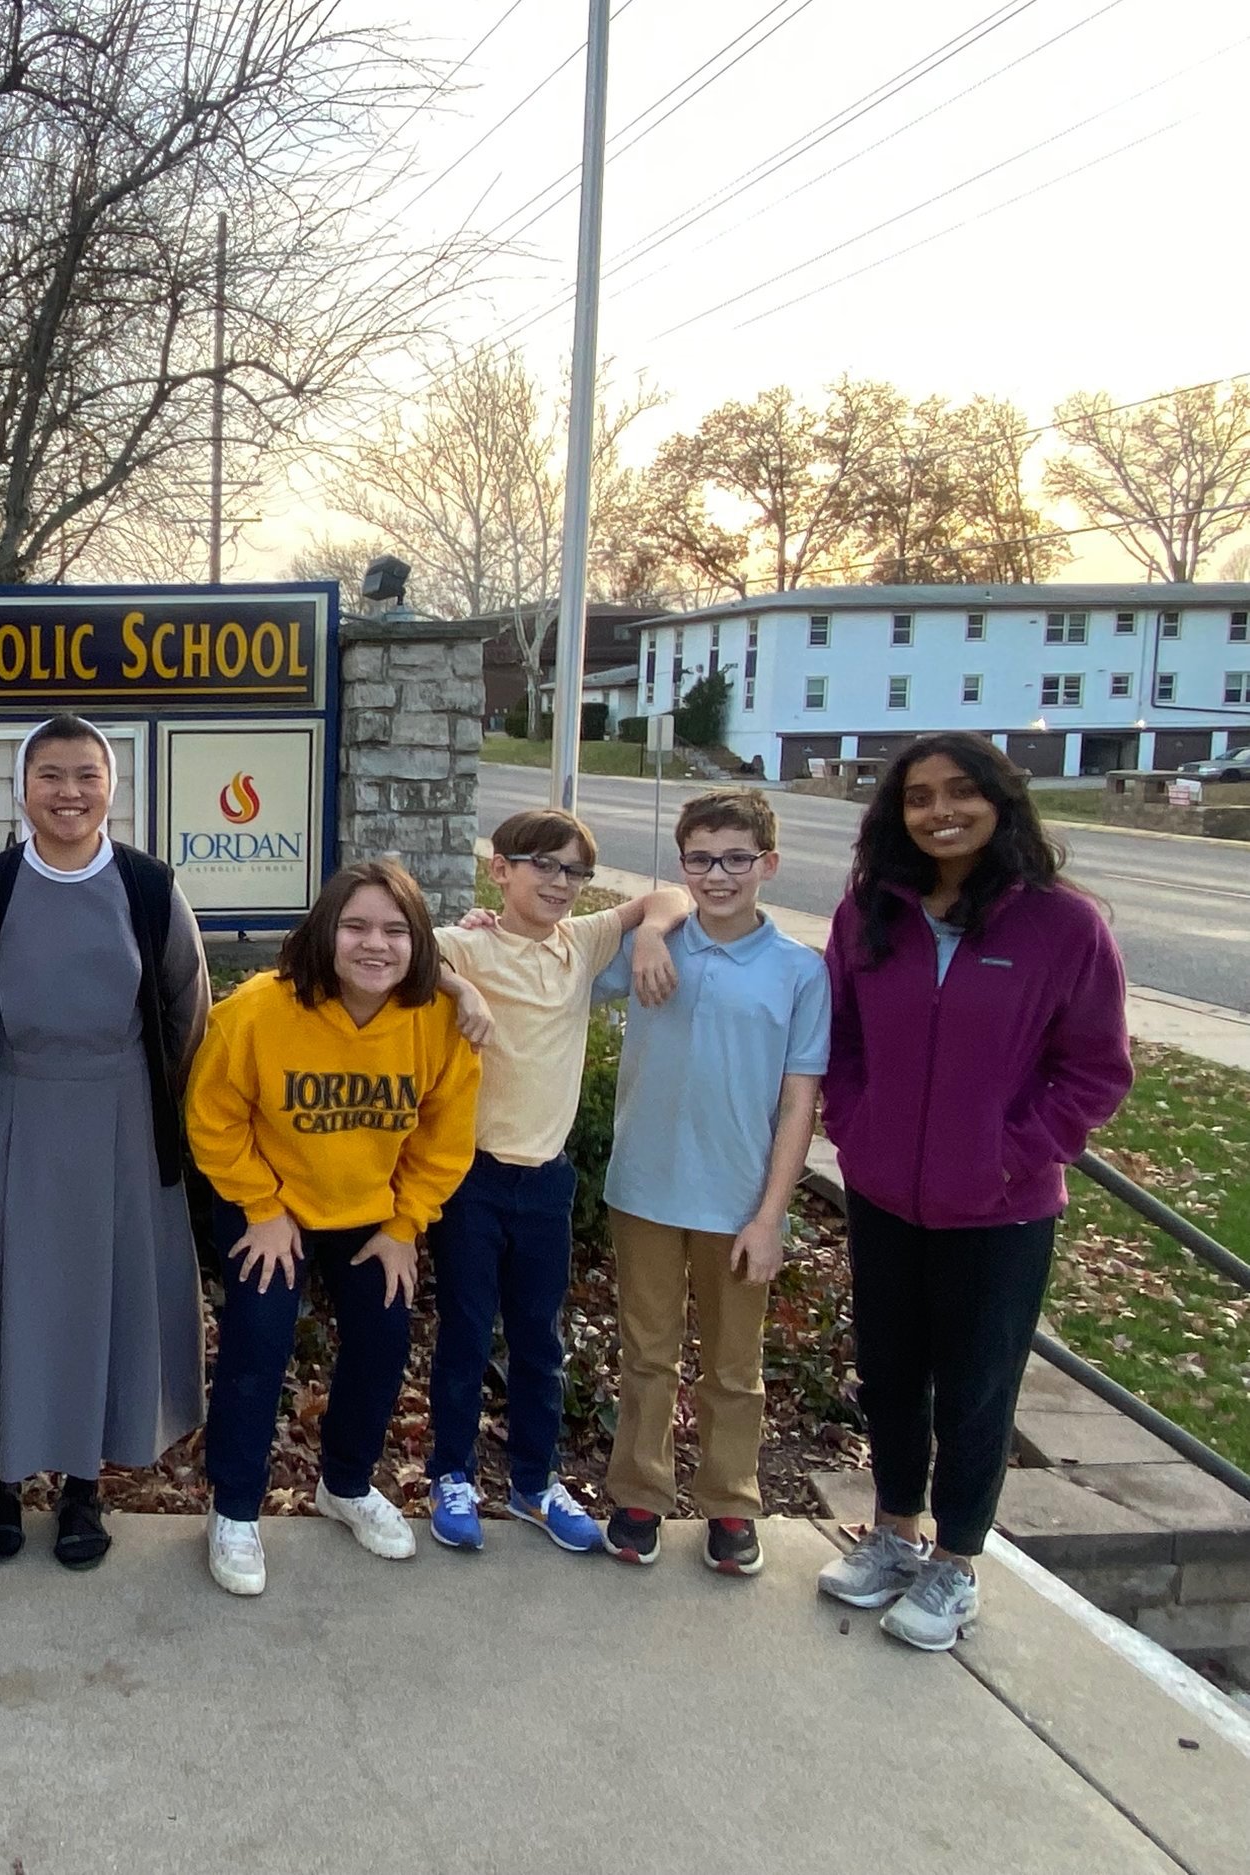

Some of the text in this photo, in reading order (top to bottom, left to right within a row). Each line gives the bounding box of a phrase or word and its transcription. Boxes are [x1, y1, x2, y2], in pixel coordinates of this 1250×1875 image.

[121, 611, 308, 680] SCHOOL
[176, 832, 302, 867] JORDAN
[280, 1069, 418, 1112] JORDAN
[292, 1110, 416, 1134] CATHOLIC
